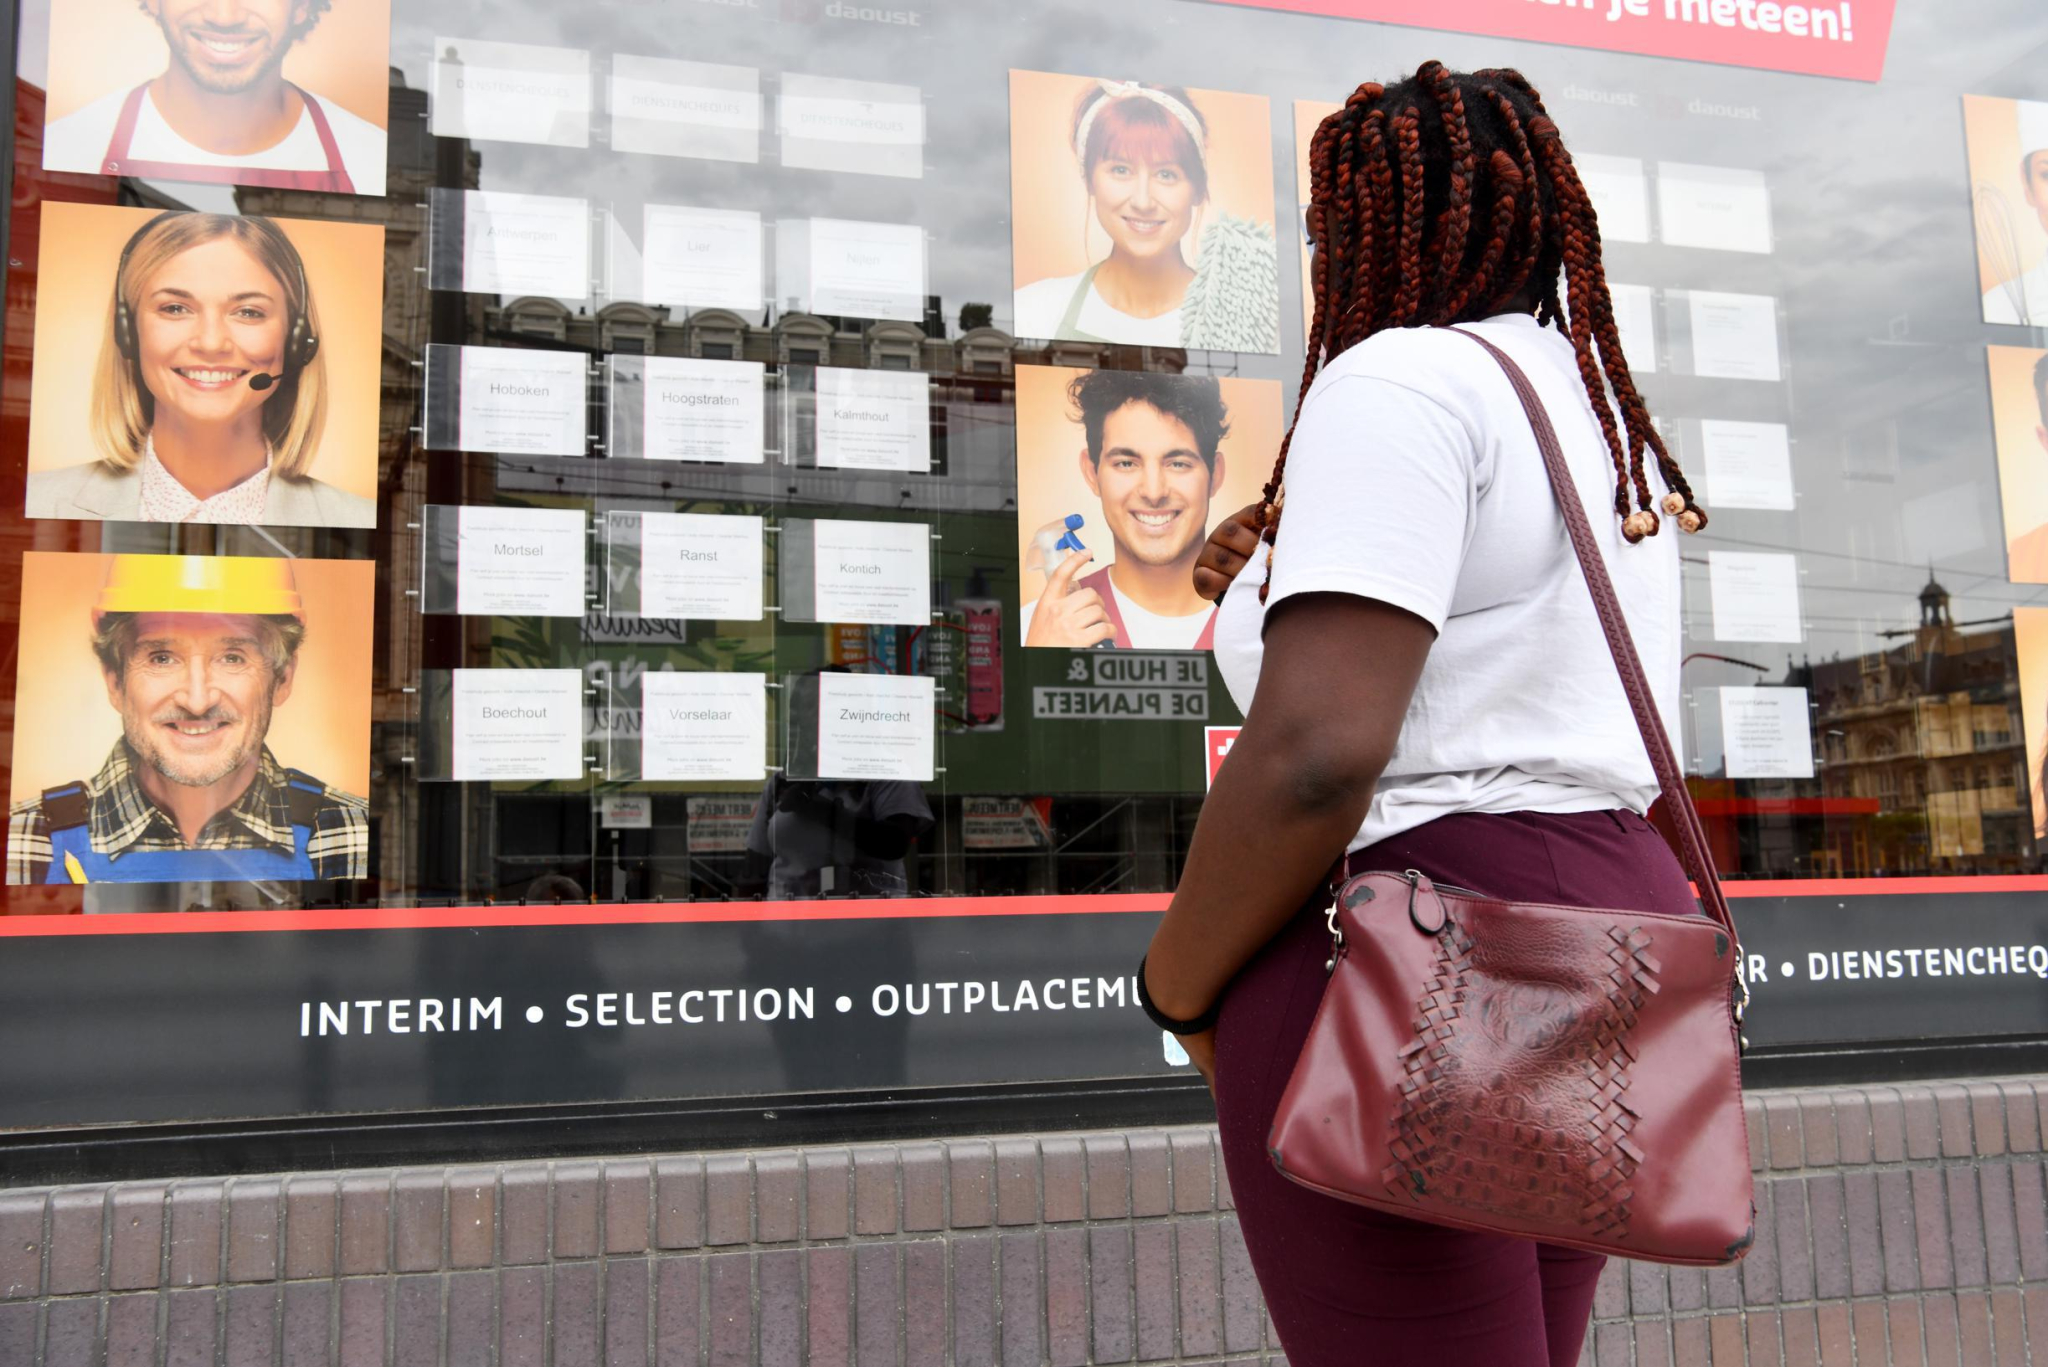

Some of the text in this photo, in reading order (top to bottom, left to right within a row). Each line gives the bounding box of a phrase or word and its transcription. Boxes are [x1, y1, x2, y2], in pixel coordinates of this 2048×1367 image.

[825, 1, 921, 27] daoust
[1664, 0, 1854, 42] meteen!
[1562, 84, 1640, 107] daoust
[631, 95, 741, 117] DIENSTENCHEQUES
[1687, 98, 1761, 120] daoust
[800, 112, 905, 132] DIENSTENCHEQUES
[487, 226, 559, 244] Antwerpen
[687, 240, 711, 253] Lier
[846, 251, 881, 267] Nijlen
[490, 382, 550, 397] Hoboken
[662, 391, 740, 408] Hoogstraten
[833, 409, 890, 423] Kalmthout
[494, 543, 544, 557] Mortsel
[680, 549, 718, 562] Ranst
[839, 562, 882, 576] Kontich
[482, 706, 547, 720] Boechout
[669, 708, 732, 722] Vorselaar
[839, 708, 911, 724] Zwijndrecht
[300, 996, 502, 1037] INTERIM
[565, 986, 814, 1029] SELECTION
[1807, 945, 2048, 981] DIENSTENCHEQ
